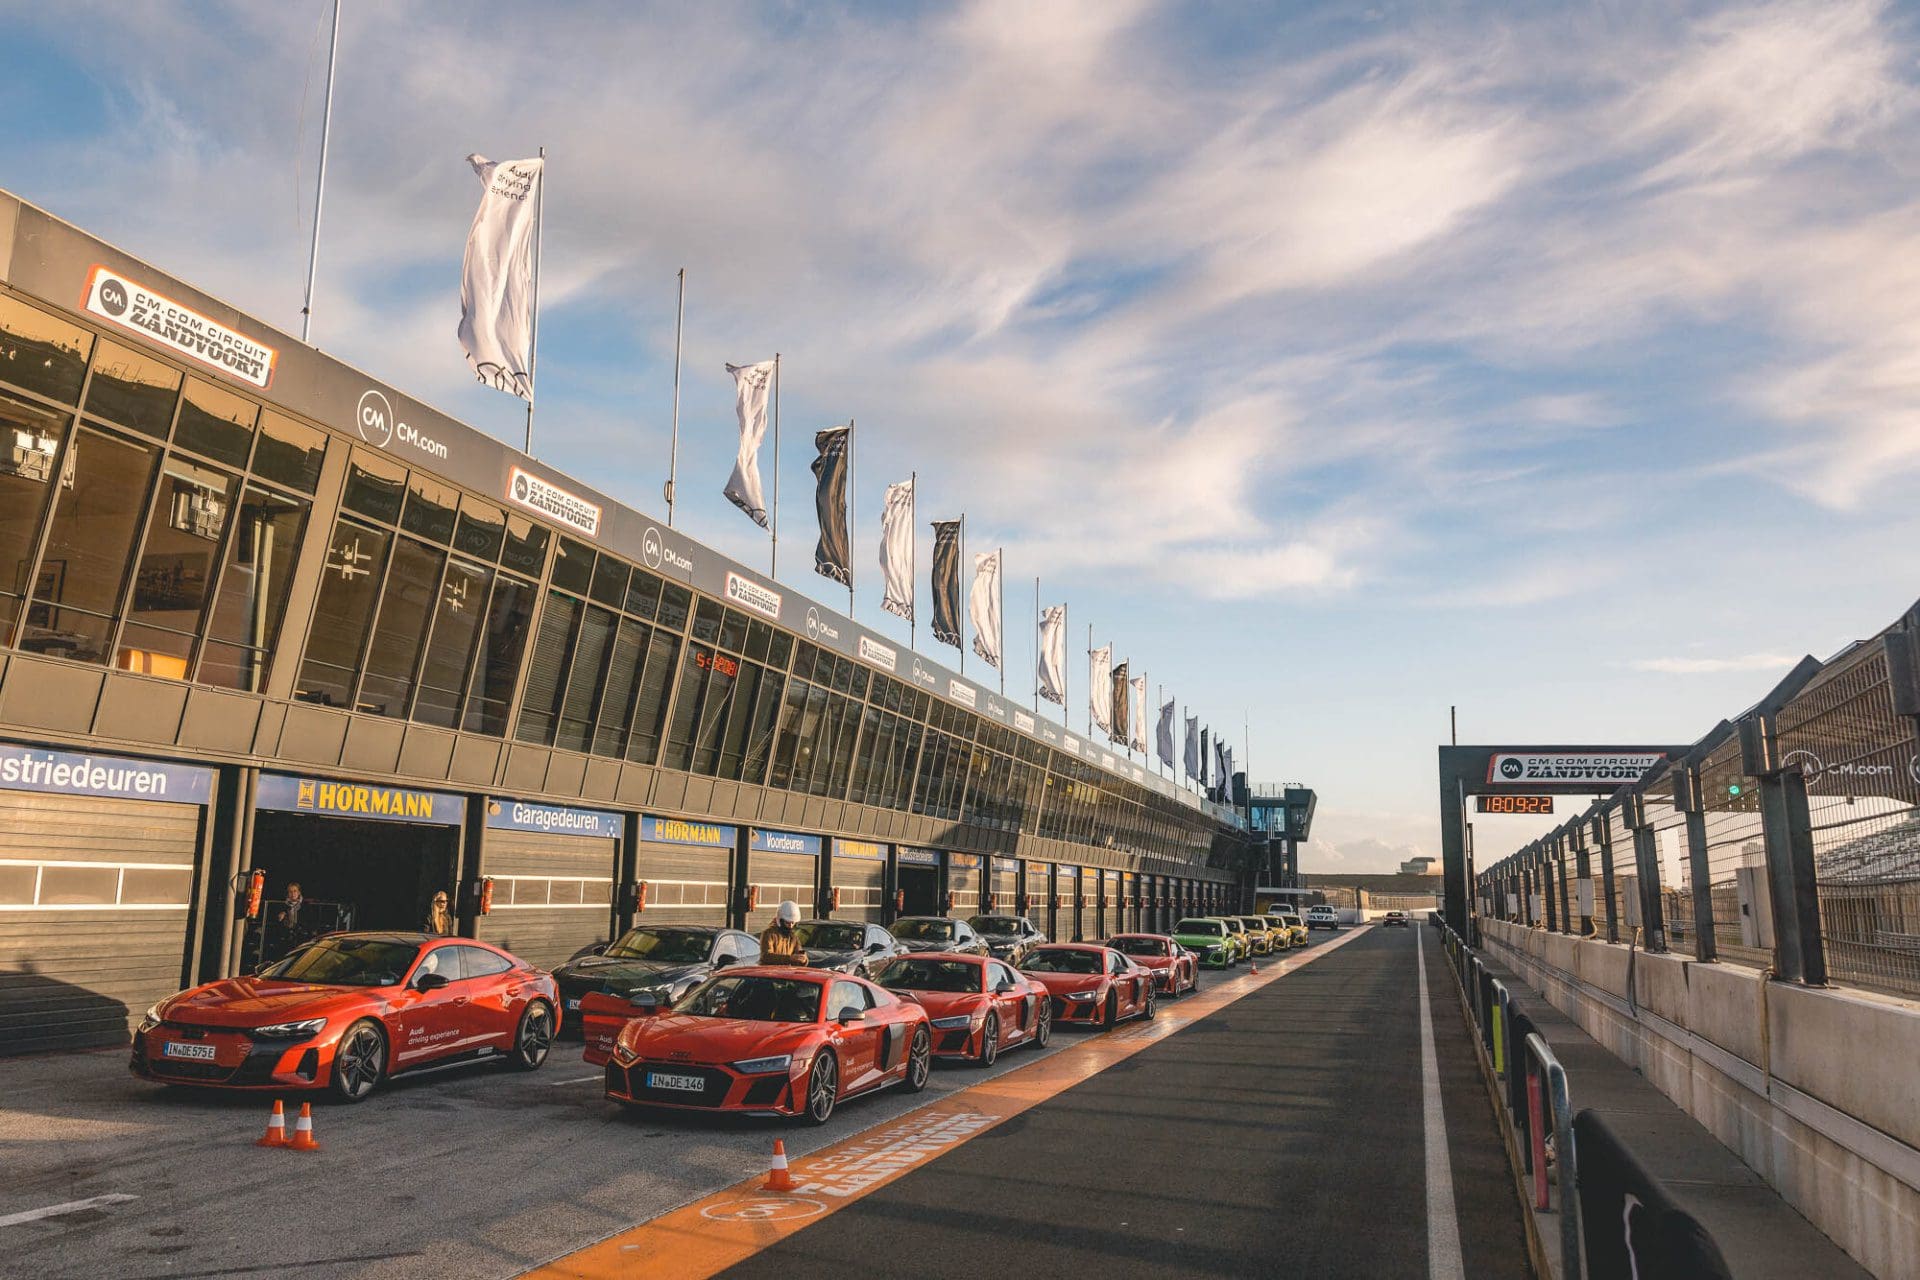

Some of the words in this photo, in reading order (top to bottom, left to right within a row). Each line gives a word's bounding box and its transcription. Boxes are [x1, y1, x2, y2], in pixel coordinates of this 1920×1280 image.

[135, 292, 203, 331] CM.COM
[207, 327, 267, 360] CIRCUIT
[129, 304, 264, 379] ZANDVOORT
[397, 422, 448, 459] CM.com
[528, 489, 595, 530] ZANDVOORT
[531, 481, 565, 502] CM.COM
[565, 498, 596, 517] CIRCUIT
[664, 548, 692, 572] CM.com
[0, 753, 167, 794] striedeuren
[1527, 758, 1592, 766] CM.COM
[1593, 758, 1654, 766] CIRCUIT
[1828, 762, 1893, 775] CM.com
[319, 783, 433, 818] HÖRMANN
[1486, 797, 1551, 813] 18:09:22
[513, 803, 599, 830] Garagedeuren
[766, 832, 805, 851] Voordeuren
[408, 1026, 424, 1036] Audi
[408, 1034, 429, 1045] driving
[429, 1028, 460, 1041] experience
[684, 1078, 704, 1090] 146
